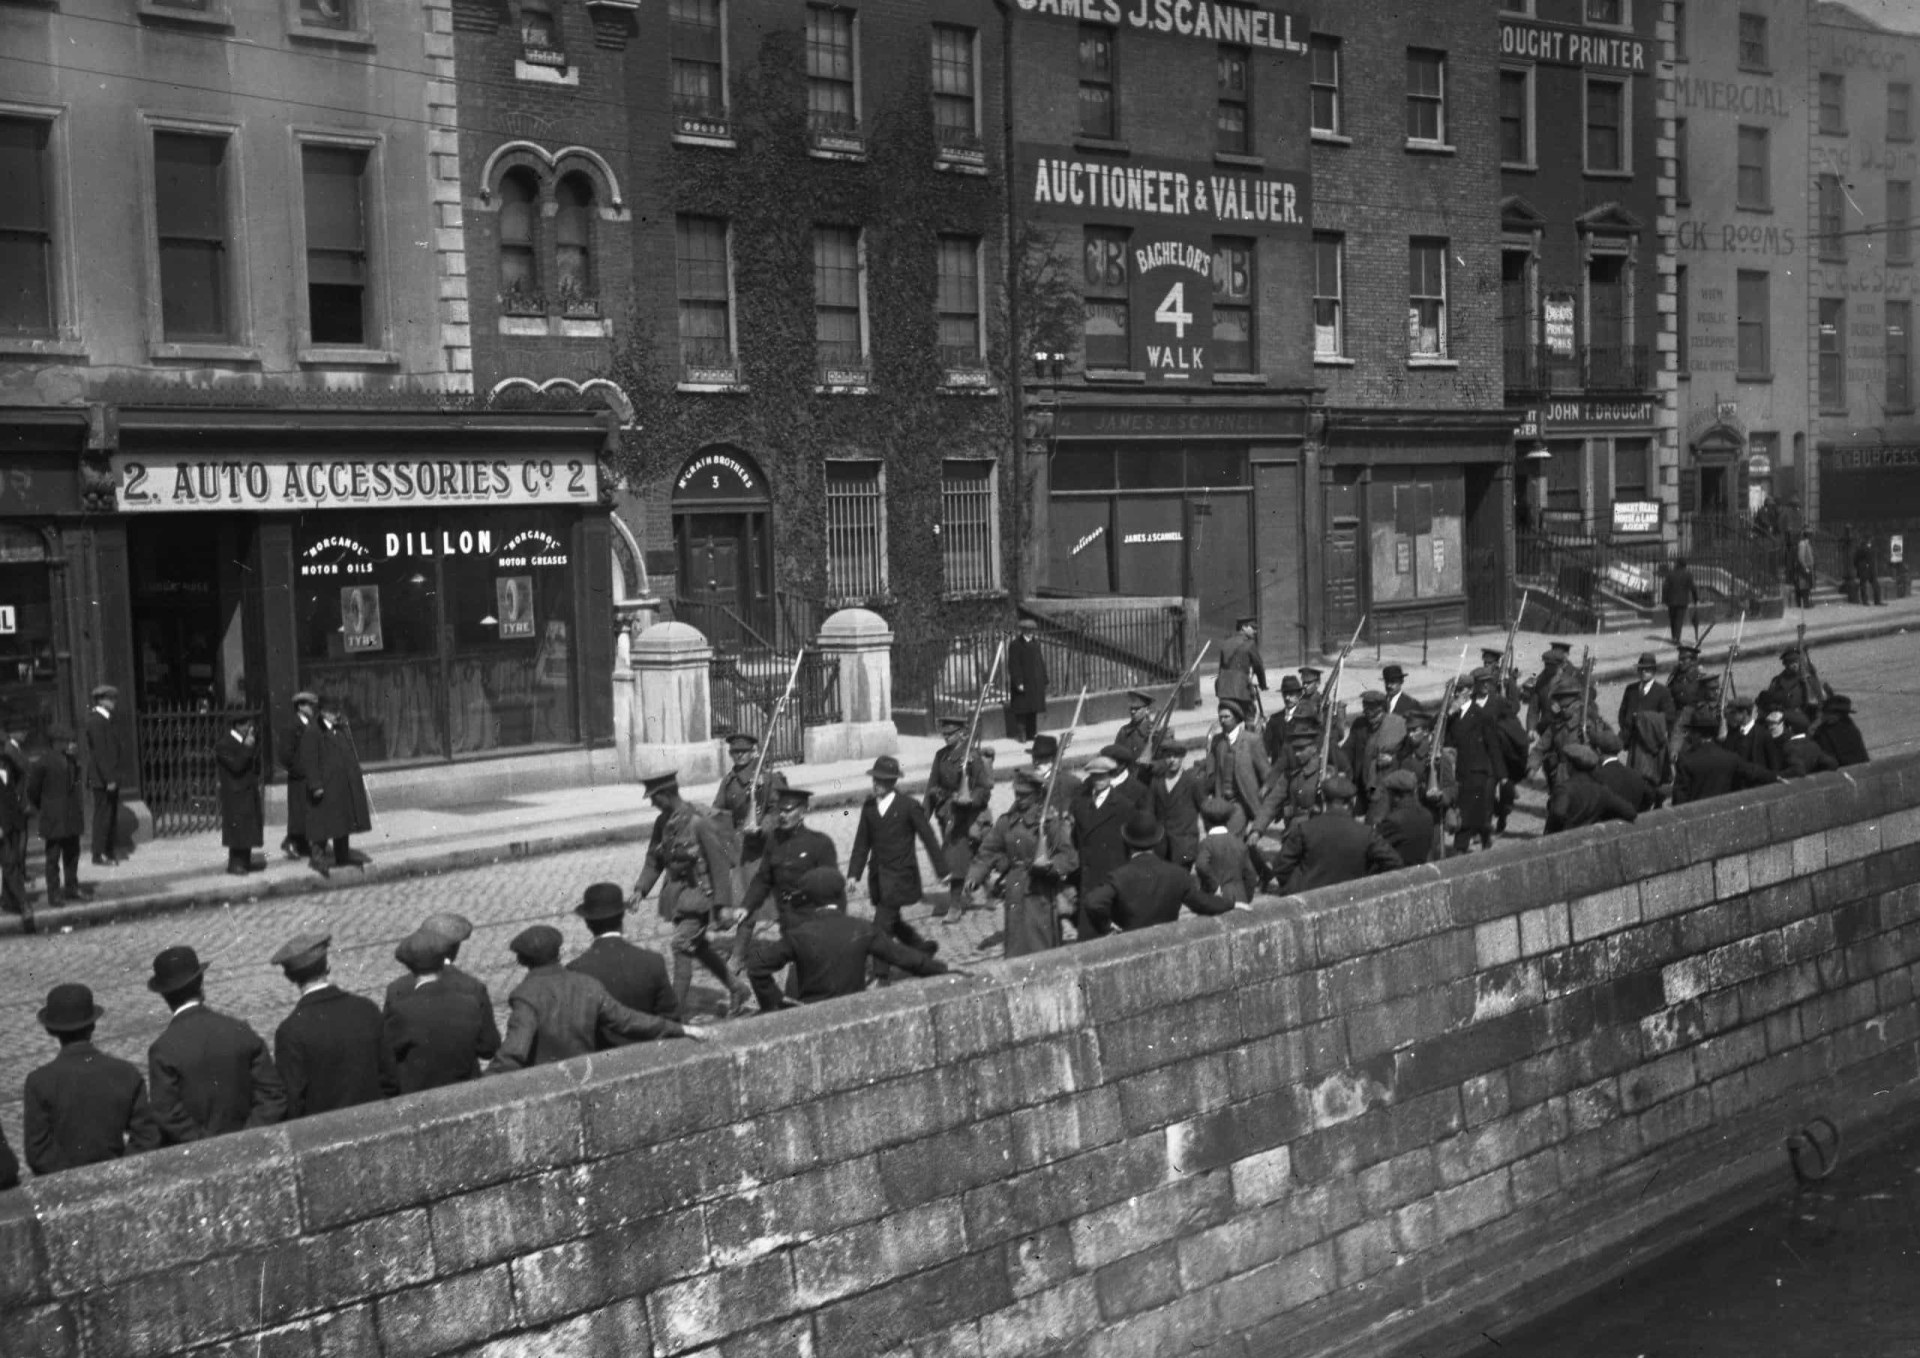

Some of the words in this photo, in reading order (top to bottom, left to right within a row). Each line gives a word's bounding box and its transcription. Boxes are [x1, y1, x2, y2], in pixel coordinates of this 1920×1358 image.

[1017, 0, 1121, 23] MES
[1499, 25, 1563, 60] OUGHT
[1569, 33, 1645, 70] PRINTER
[1034, 158, 1191, 215] AUCTIONEER
[1194, 179, 1208, 211] &
[1210, 175, 1303, 224] VALUER.
[1154, 281, 1194, 339] 4
[1146, 345, 1204, 370] WALK
[1547, 403, 1580, 420] JOHN
[172, 461, 271, 503] AUTO
[283, 459, 512, 503] ACCESSORIES
[567, 459, 589, 497] 2
[712, 475, 719, 489] 3
[713, 455, 753, 489] BROTHERS
[1621, 523, 1650, 532] AGENT
[386, 530, 491, 557] DILLON
[301, 565, 338, 575] MOTOR
[347, 562, 373, 573] OILS
[499, 557, 526, 567] MOTOR
[531, 555, 567, 566] GREASES
